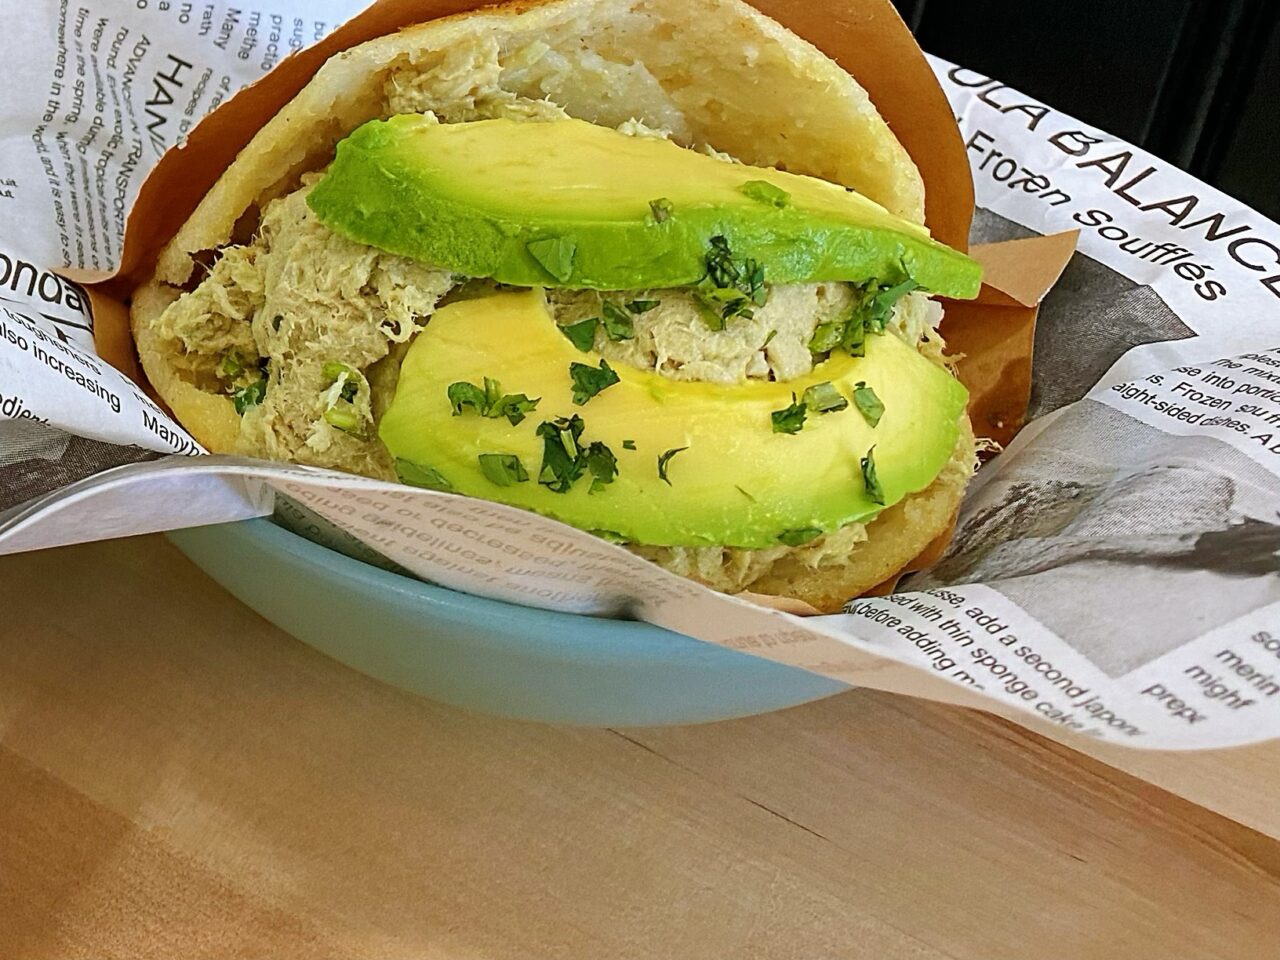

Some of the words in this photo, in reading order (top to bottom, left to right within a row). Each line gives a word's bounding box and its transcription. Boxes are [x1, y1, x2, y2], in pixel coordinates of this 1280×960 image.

[74, 7, 90, 38] time
[178, 2, 192, 24] no
[213, 7, 242, 50] Many
[967, 129, 1071, 207] Frozen
[1073, 209, 1227, 303] Soufflés
[1047, 129, 1280, 298] BALANC
[32, 341, 122, 413] increasing
[1171, 381, 1233, 411] Frozen
[1201, 371, 1235, 390] into
[857, 602, 902, 628] before
[897, 624, 957, 671] adding
[910, 601, 943, 623] with
[938, 619, 974, 647] thin
[971, 648, 1038, 701] sponge
[965, 606, 1008, 635] add
[999, 634, 1017, 647] a
[1014, 645, 1090, 699] second
